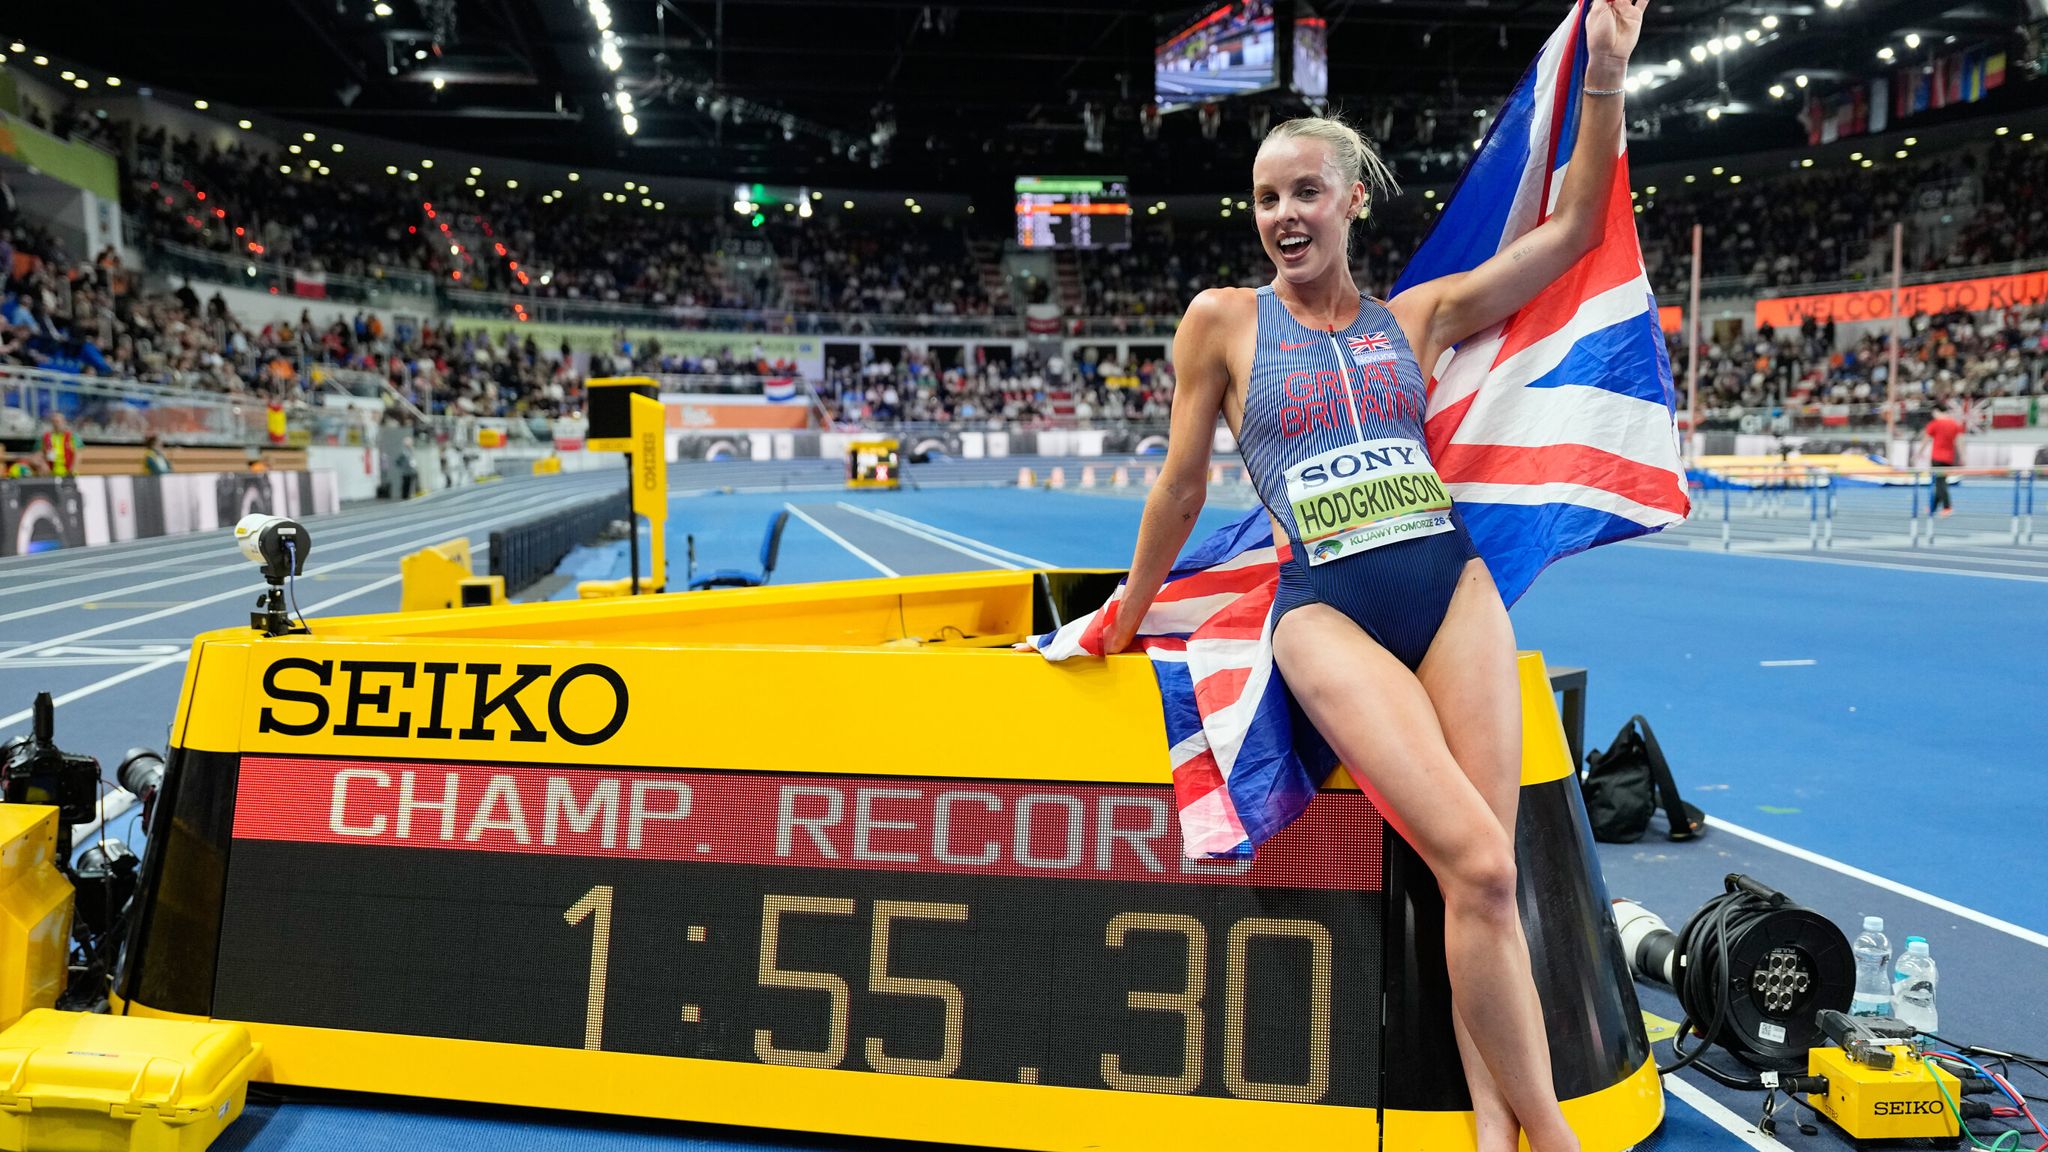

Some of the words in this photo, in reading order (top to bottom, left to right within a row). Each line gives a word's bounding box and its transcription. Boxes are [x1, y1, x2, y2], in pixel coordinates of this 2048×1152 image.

[1785, 290, 1928, 320] WELCOME
[1941, 285, 1977, 307] TO
[1989, 274, 2048, 307] KUJ
[1284, 360, 1399, 401] GREAT
[1280, 389, 1417, 438] BRITAIN
[1300, 446, 1415, 490] SONY
[1300, 474, 1445, 534] HODGKINSON
[1349, 523, 1392, 546] KUJAWY
[1394, 518, 1434, 534] POMORZE
[1434, 516, 1446, 526] 26
[258, 656, 630, 746] SEIKO
[328, 768, 711, 853] CHAMP.
[773, 783, 1254, 876] RECOR
[563, 884, 1333, 1103] 1:55.30
[1874, 1100, 1944, 1116] SEIKO
